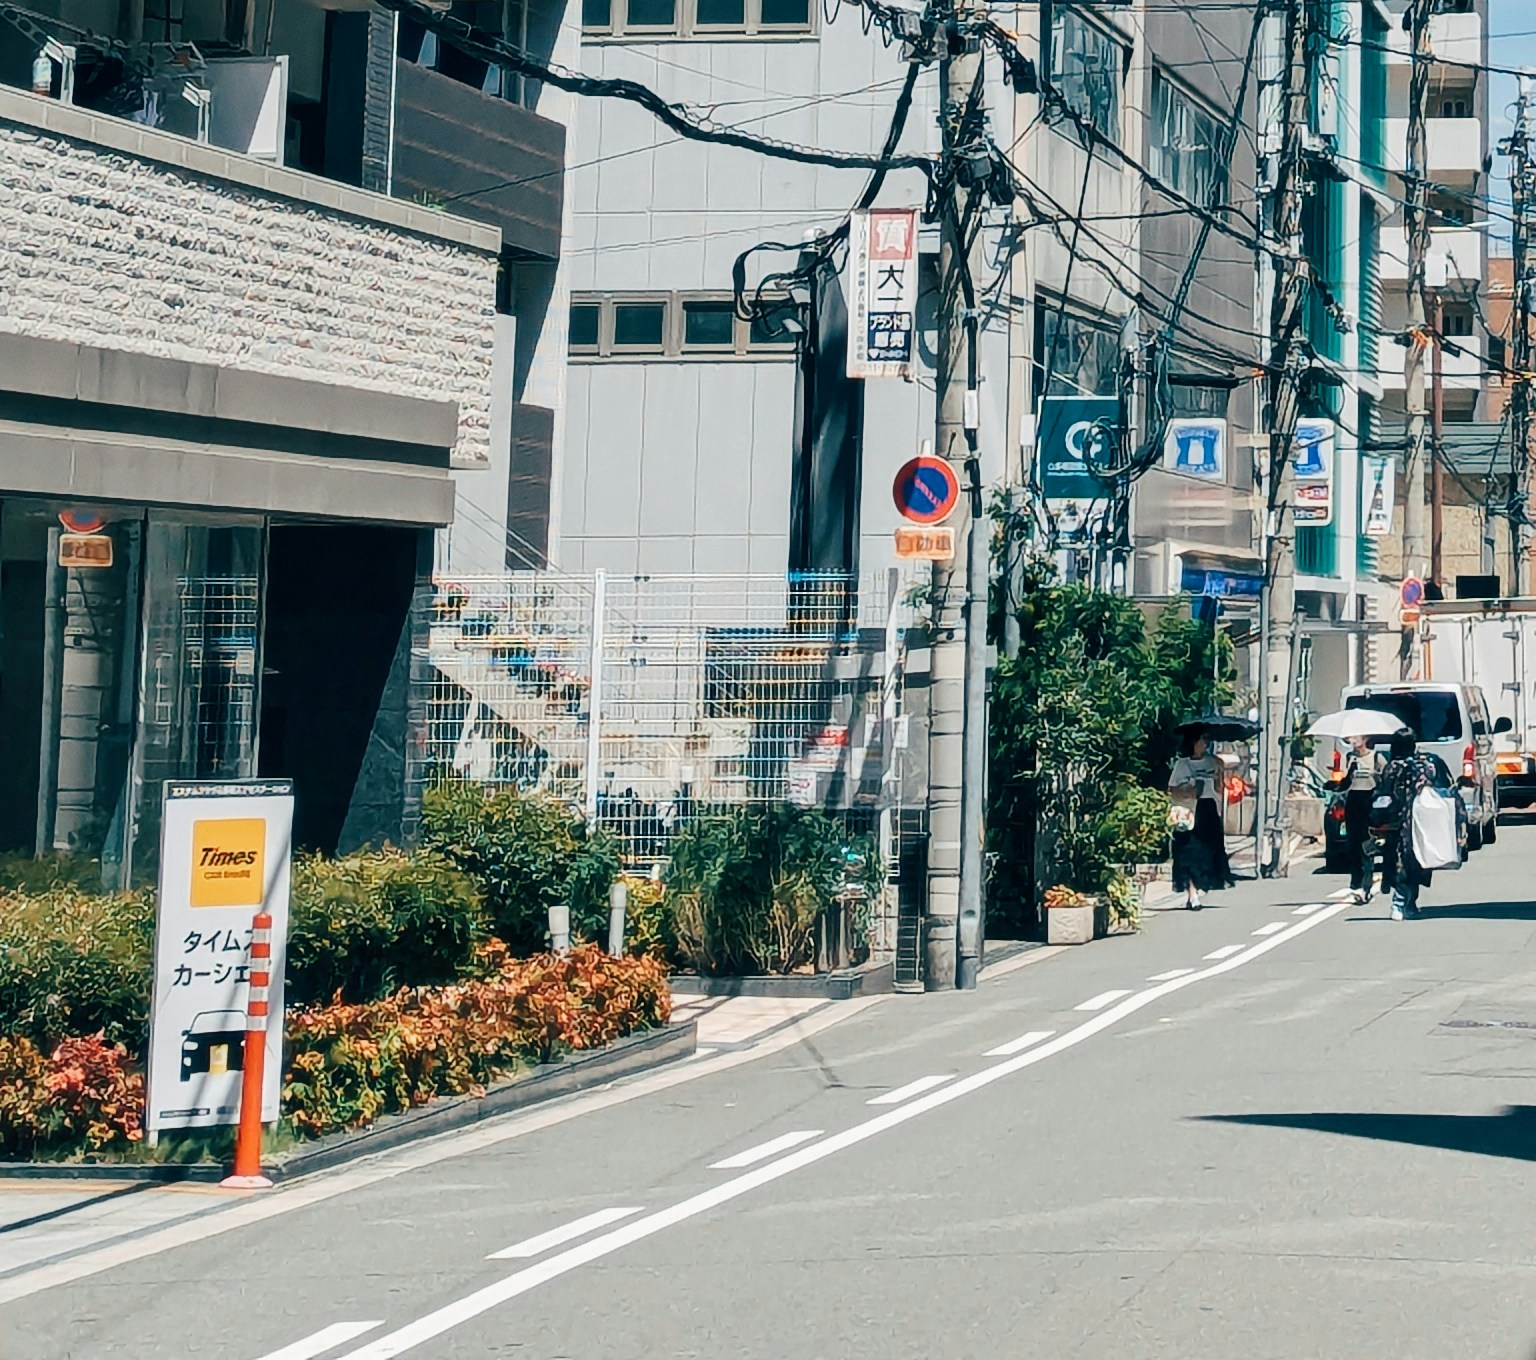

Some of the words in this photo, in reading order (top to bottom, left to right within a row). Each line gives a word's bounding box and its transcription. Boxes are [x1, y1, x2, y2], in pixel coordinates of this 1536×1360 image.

[200, 846, 257, 866] Times
[173, 963, 251, 986] カーシェ
